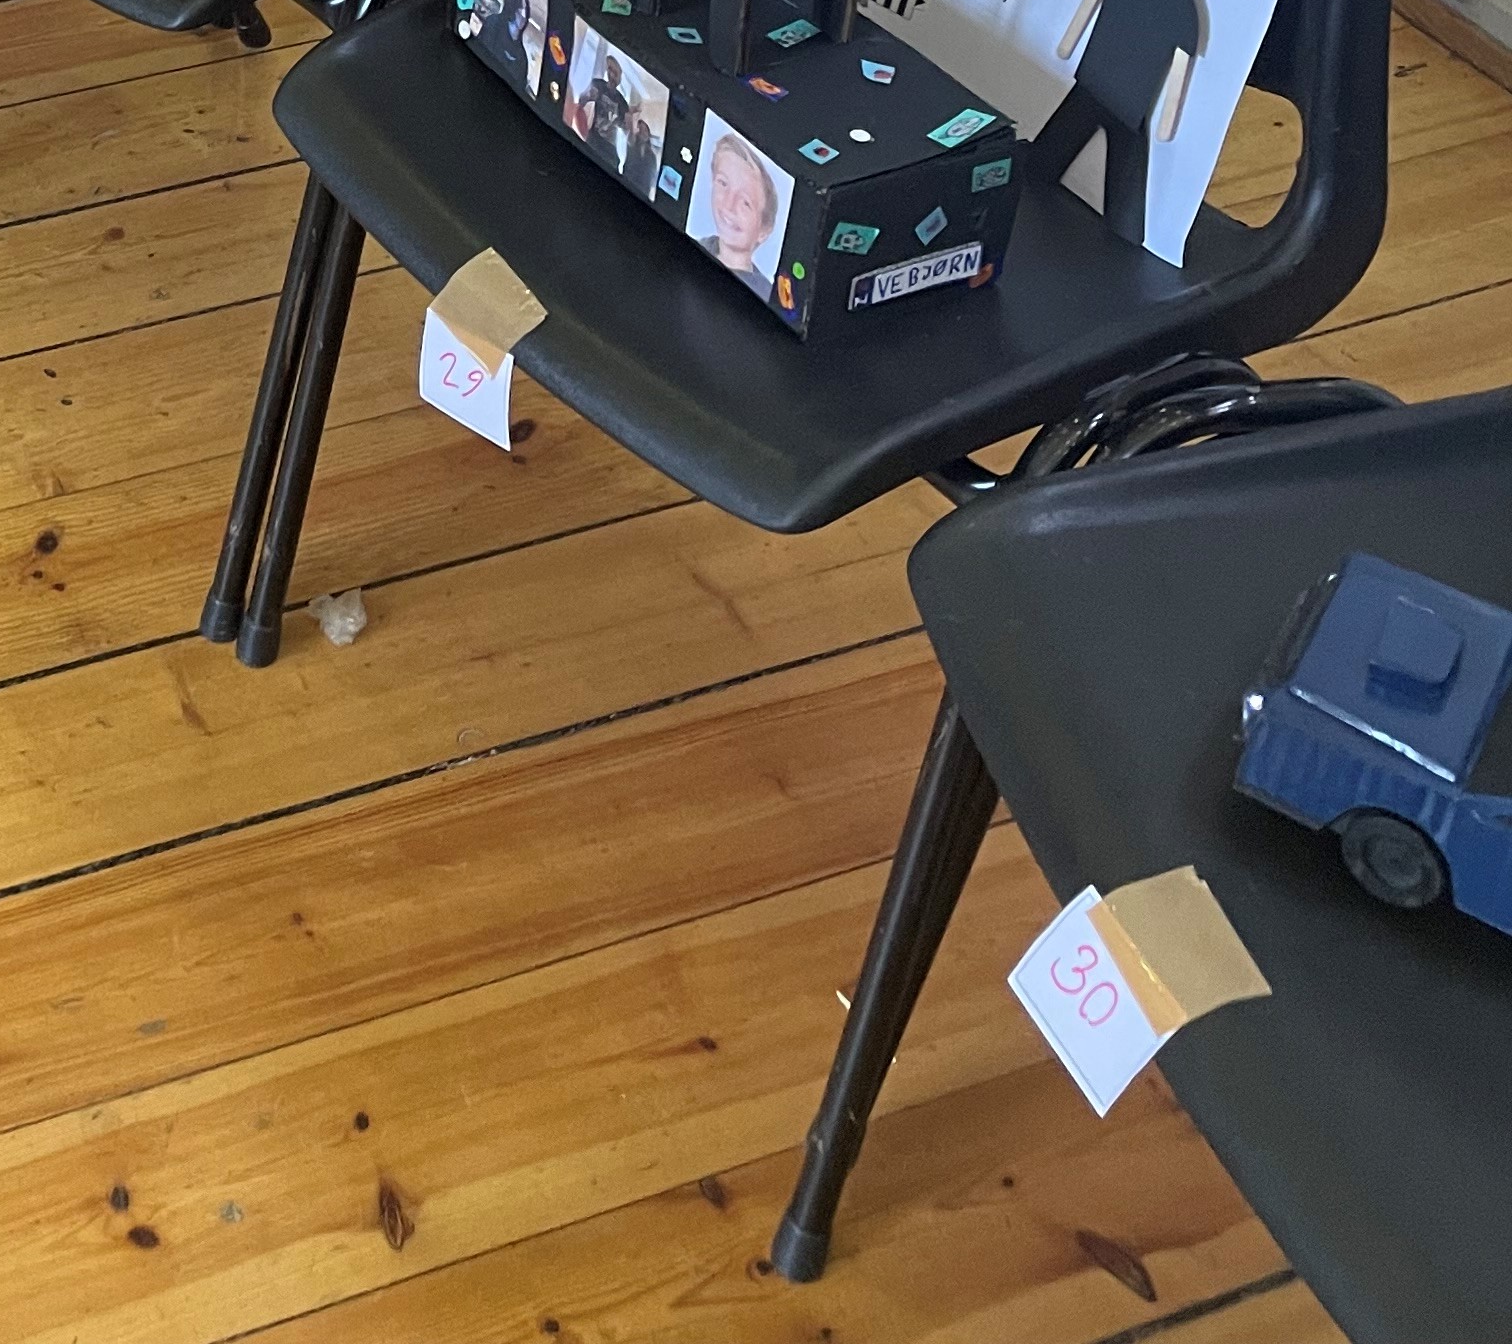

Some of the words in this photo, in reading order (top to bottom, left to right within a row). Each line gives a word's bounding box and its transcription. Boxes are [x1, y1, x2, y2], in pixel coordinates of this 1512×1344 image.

[877, 250, 979, 299] VEBJØRN
[439, 351, 484, 397] 29
[1050, 944, 1119, 1028] 30
